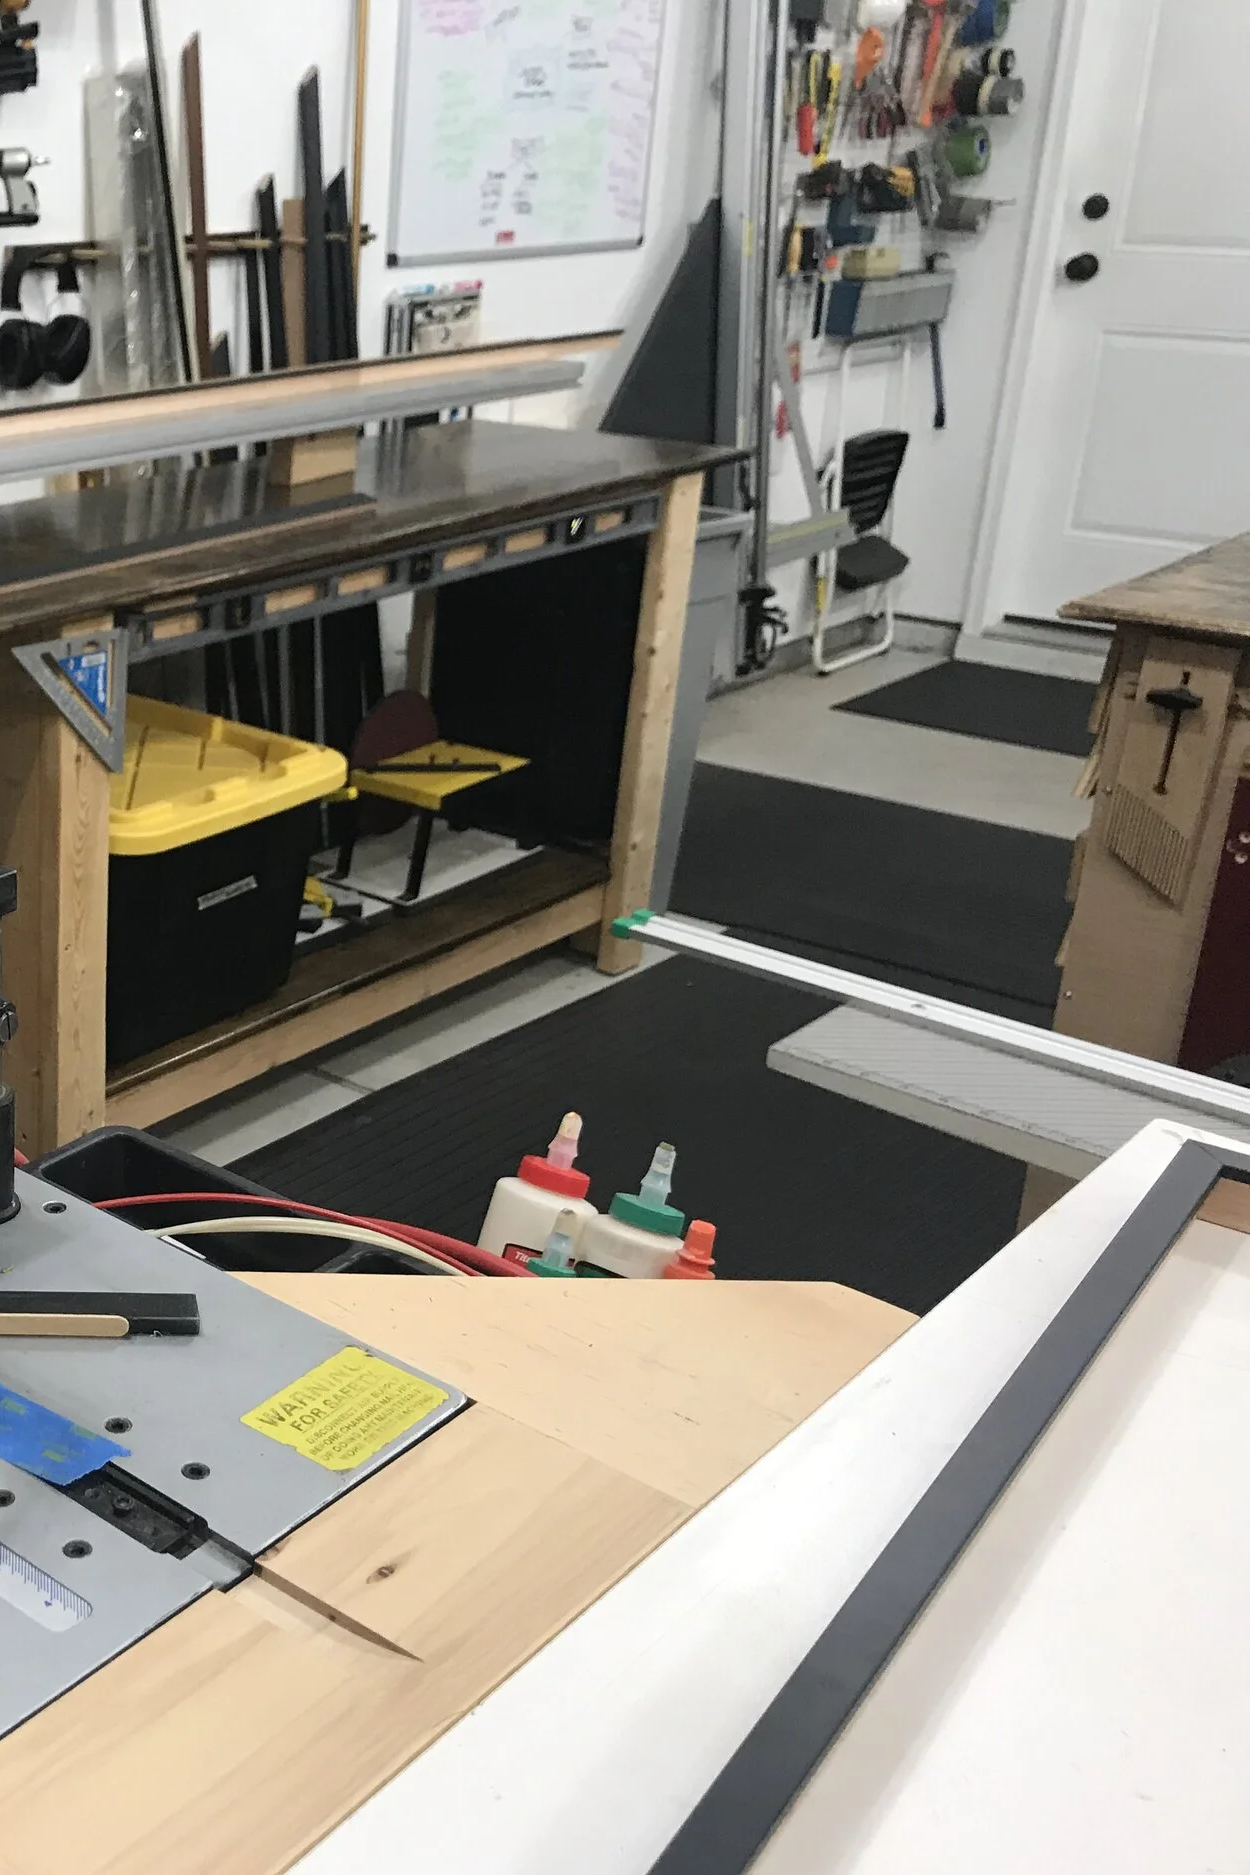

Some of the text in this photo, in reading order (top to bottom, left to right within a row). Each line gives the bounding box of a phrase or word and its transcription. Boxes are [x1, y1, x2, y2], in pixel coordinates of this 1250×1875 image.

[289, 1406, 328, 1432] FOR
[319, 1369, 382, 1410] SAFETY
[306, 1402, 385, 1456] BEFORE CHANGING
